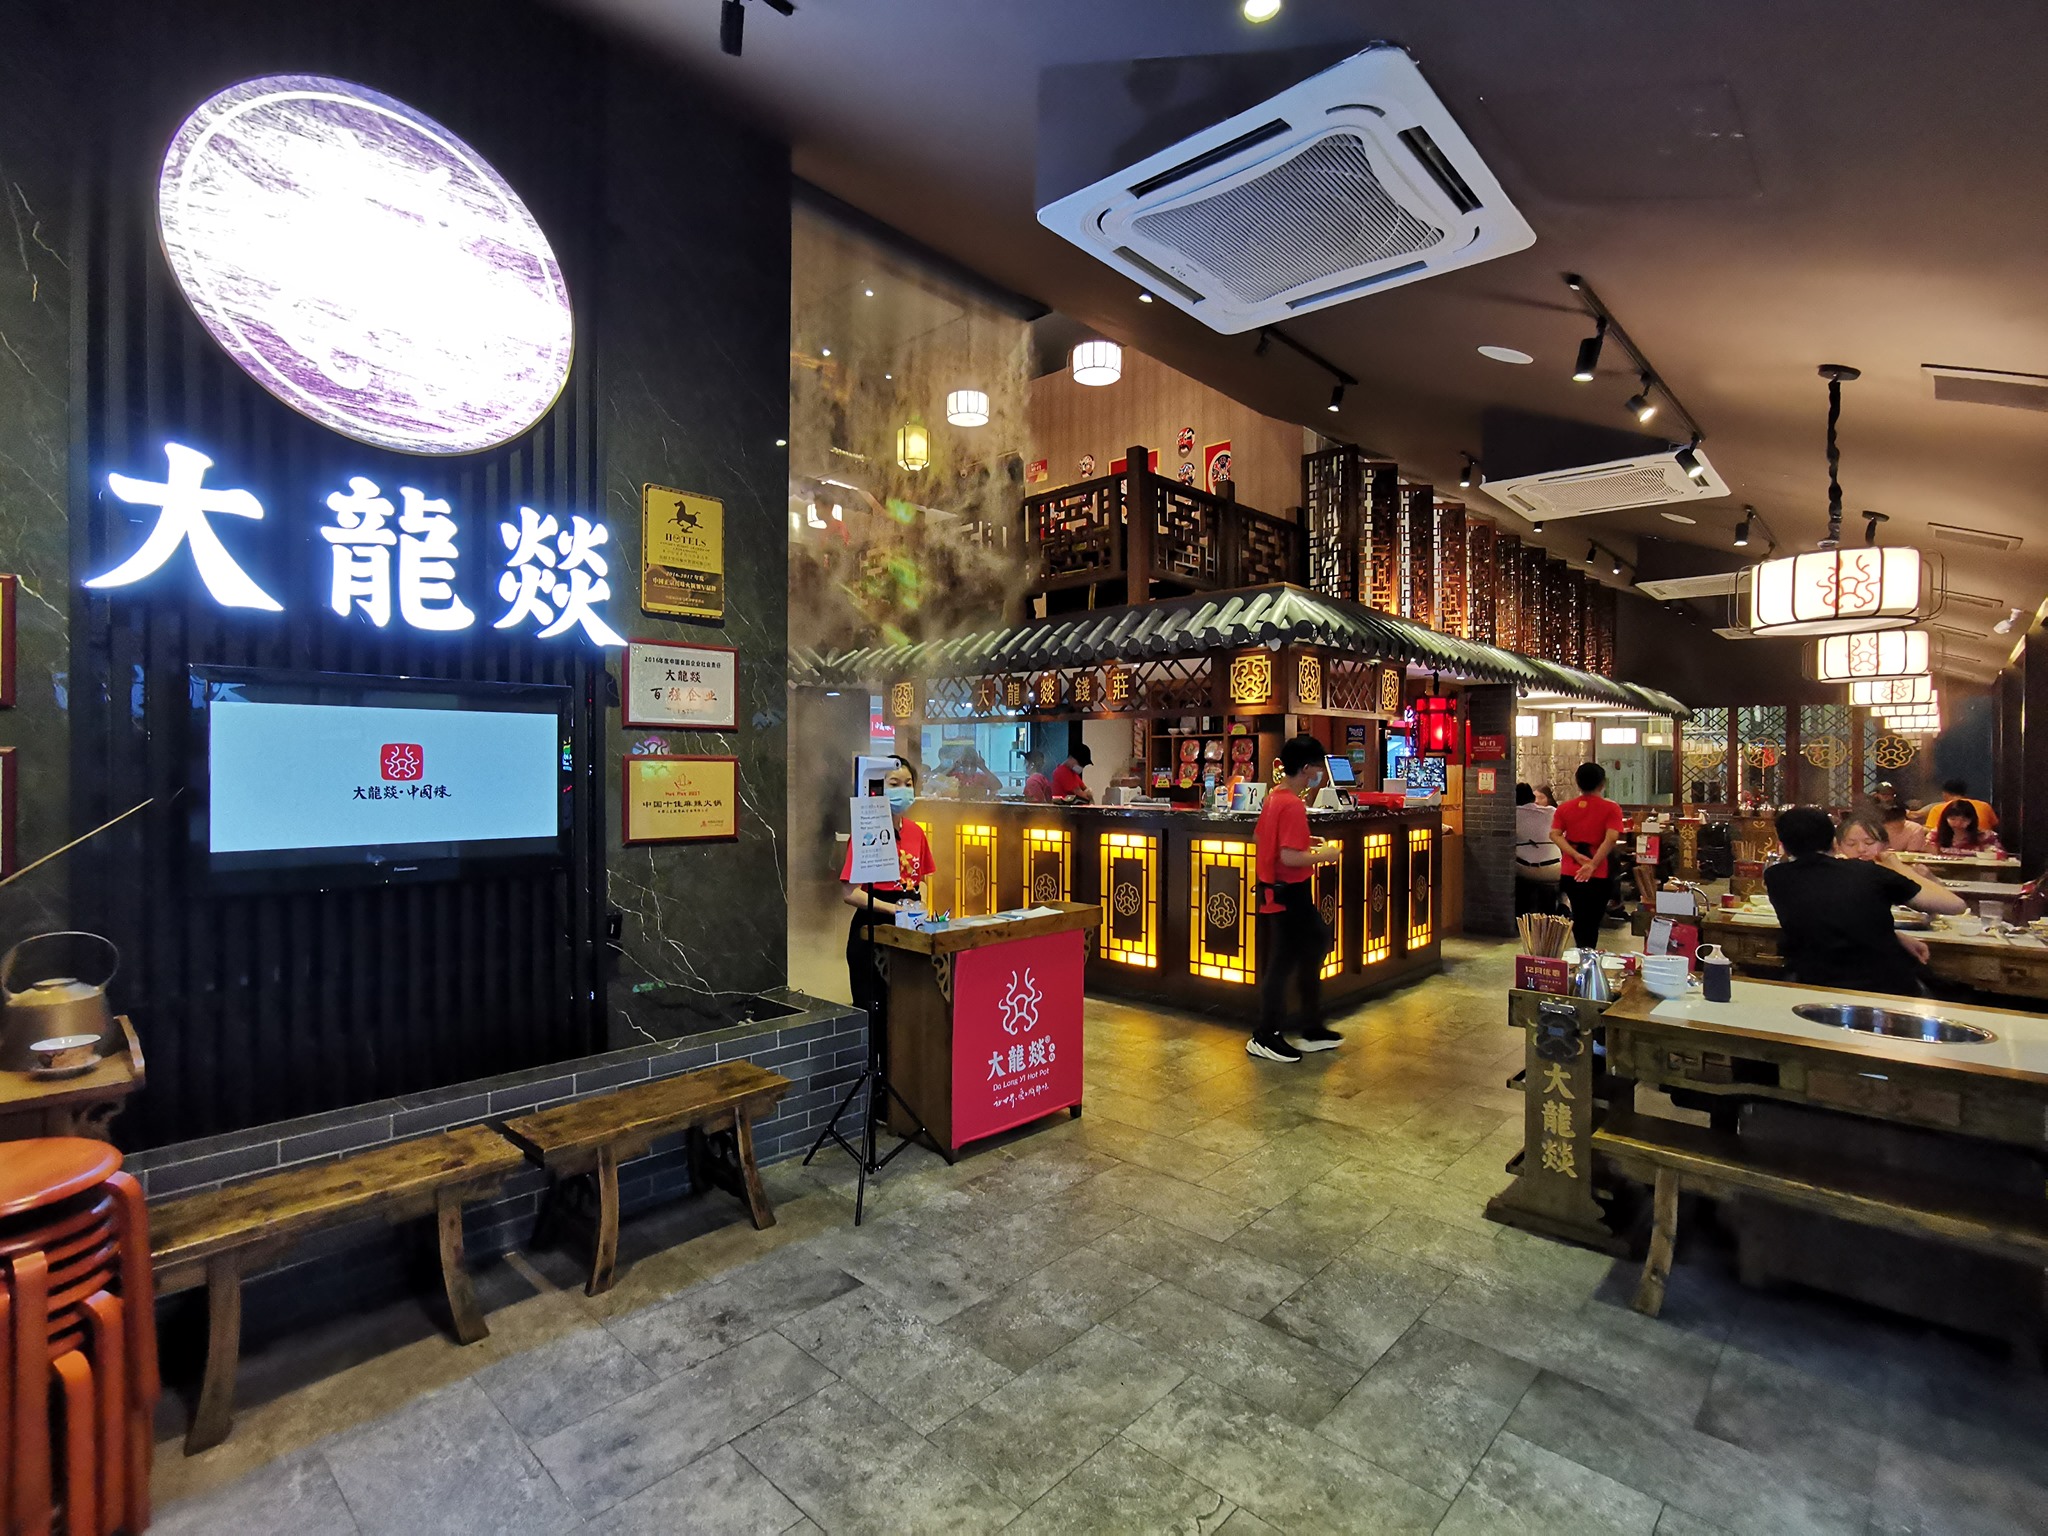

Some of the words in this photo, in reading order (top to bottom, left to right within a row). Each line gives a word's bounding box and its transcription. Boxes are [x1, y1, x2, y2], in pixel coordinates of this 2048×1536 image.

[84, 442, 628, 648] 大龍燚
[665, 533, 707, 548] HOTELS
[644, 656, 722, 669] 2016年度中国食品企业社会责任
[665, 669, 702, 684] 大龍燚
[987, 1038, 1047, 1081] 大龍燚
[993, 1083, 1002, 1091] Da
[1003, 1078, 1018, 1088] Long
[1027, 1071, 1038, 1080] Hot
[1039, 1067, 1050, 1077] Pot
[1541, 1063, 1579, 1179] 大龍燚
